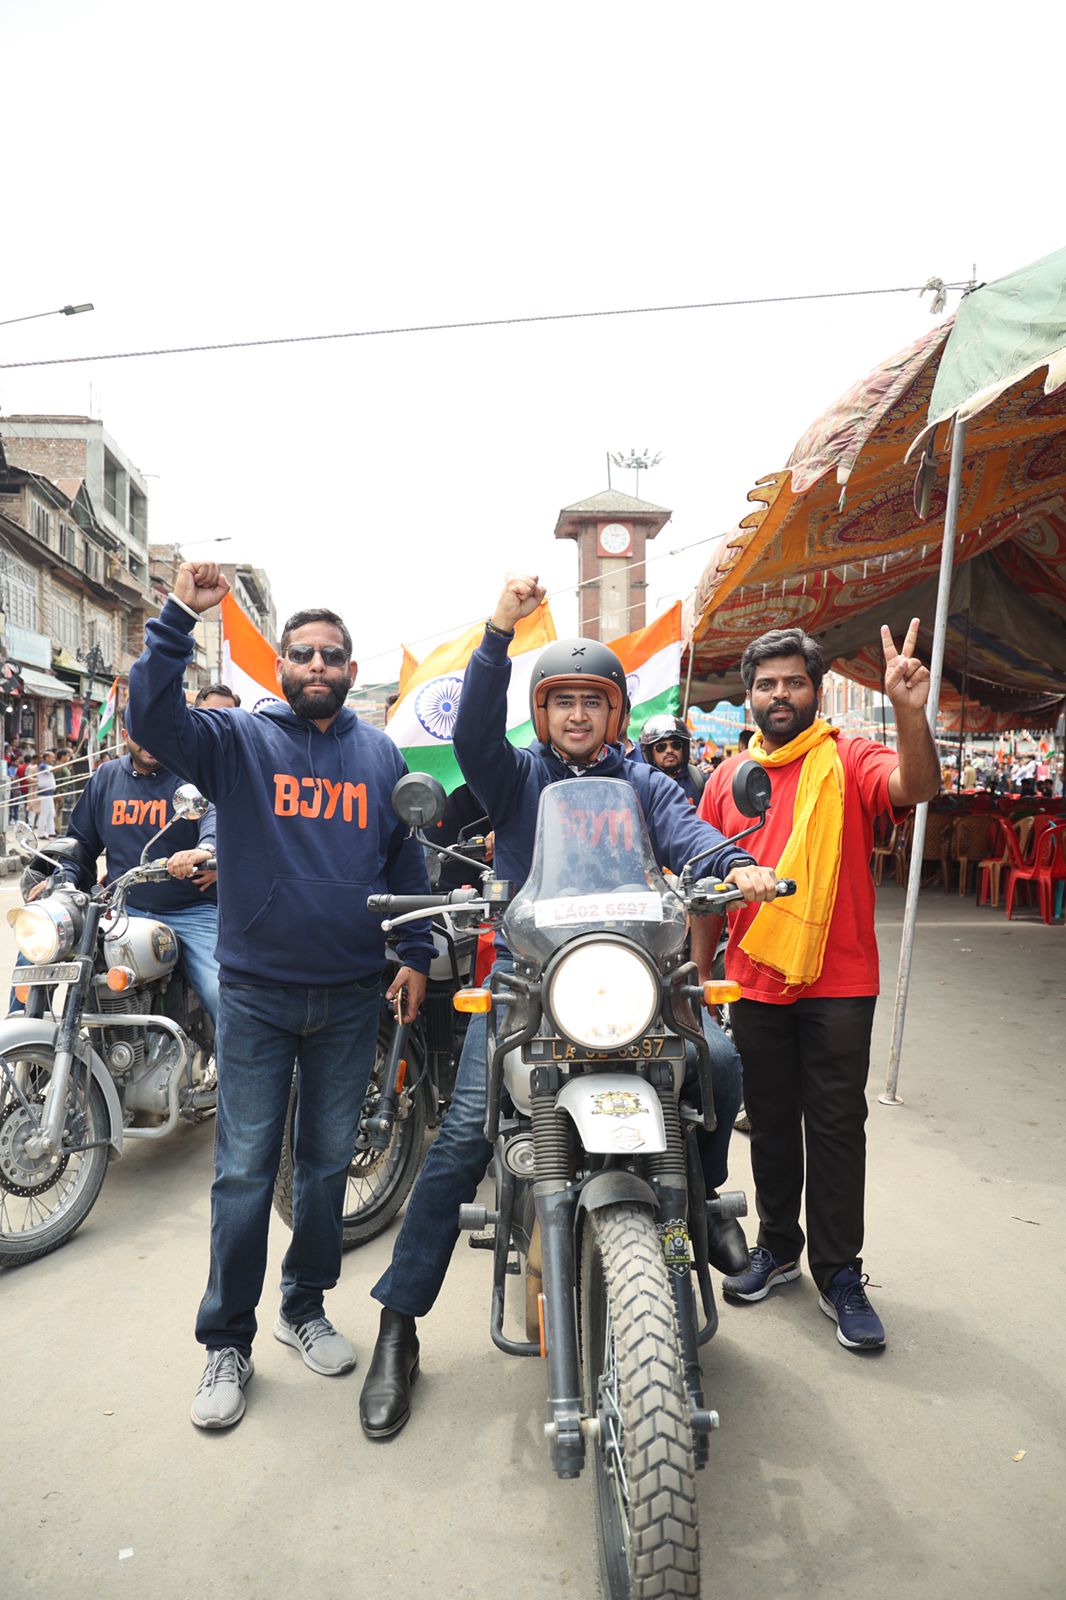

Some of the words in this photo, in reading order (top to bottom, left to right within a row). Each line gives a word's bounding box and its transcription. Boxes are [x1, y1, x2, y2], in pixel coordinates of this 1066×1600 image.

[273, 773, 368, 830] BJYM
[111, 799, 167, 829] BJYM
[605, 902, 648, 917] 6597
[552, 1041, 576, 1060] LA
